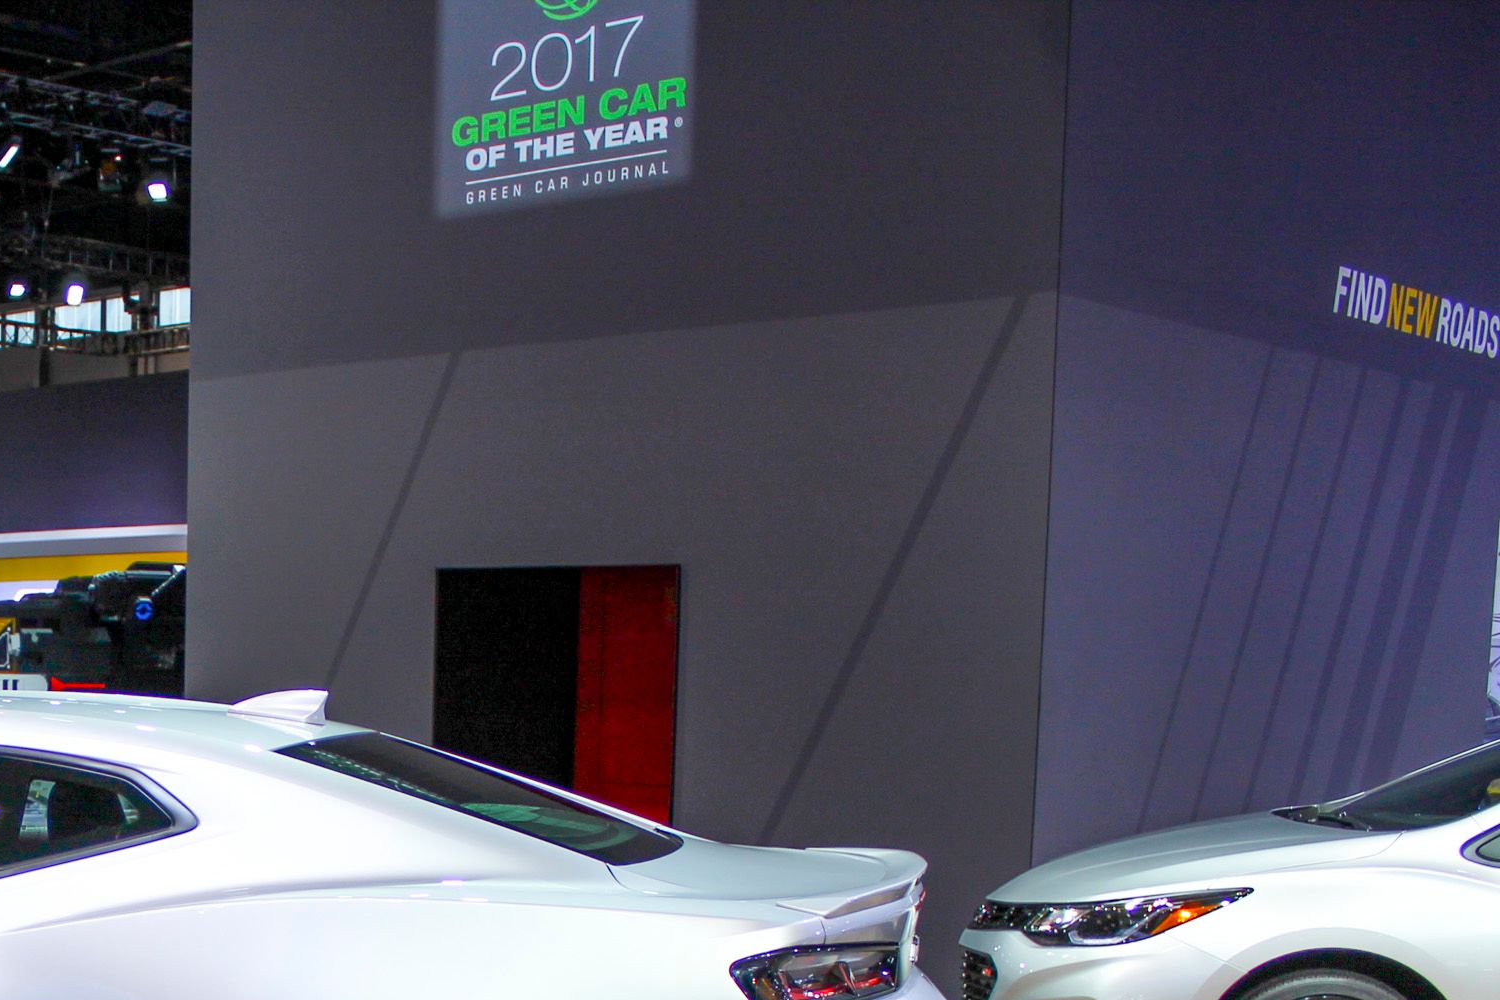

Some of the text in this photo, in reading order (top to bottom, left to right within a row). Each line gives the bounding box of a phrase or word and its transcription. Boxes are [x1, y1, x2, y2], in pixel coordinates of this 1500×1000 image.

[490, 15, 644, 101] 2017
[451, 77, 687, 147] GREEN CAR
[465, 144, 506, 172] OF
[514, 132, 575, 162] THE
[466, 160, 669, 205] GREEN CAR JOURNAL
[1332, 265, 1500, 359] FIND NEW ROADS
